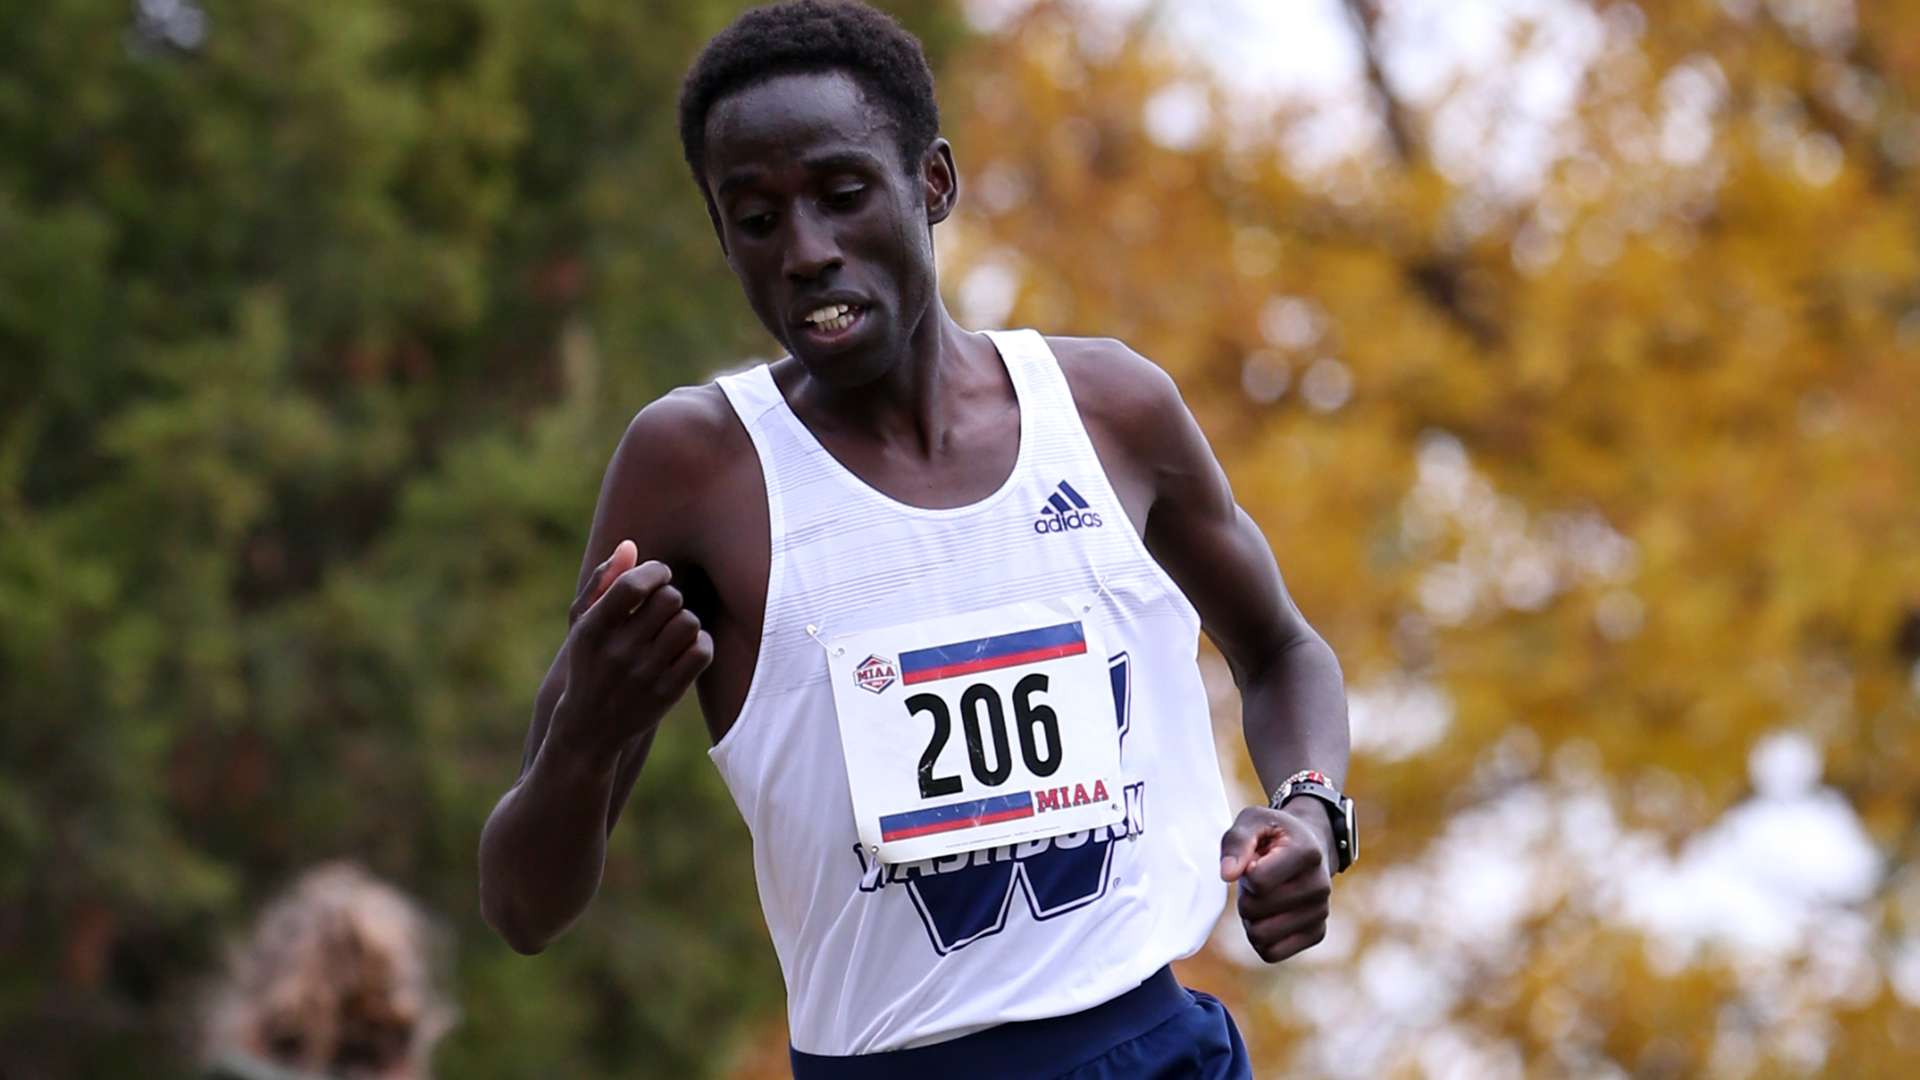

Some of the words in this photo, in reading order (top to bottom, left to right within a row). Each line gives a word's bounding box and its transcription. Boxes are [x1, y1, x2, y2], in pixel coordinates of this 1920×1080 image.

[1034, 509, 1103, 534] adidas
[857, 666, 896, 682] MIAA
[904, 673, 1063, 799] 206
[1035, 779, 1109, 813] MIAA
